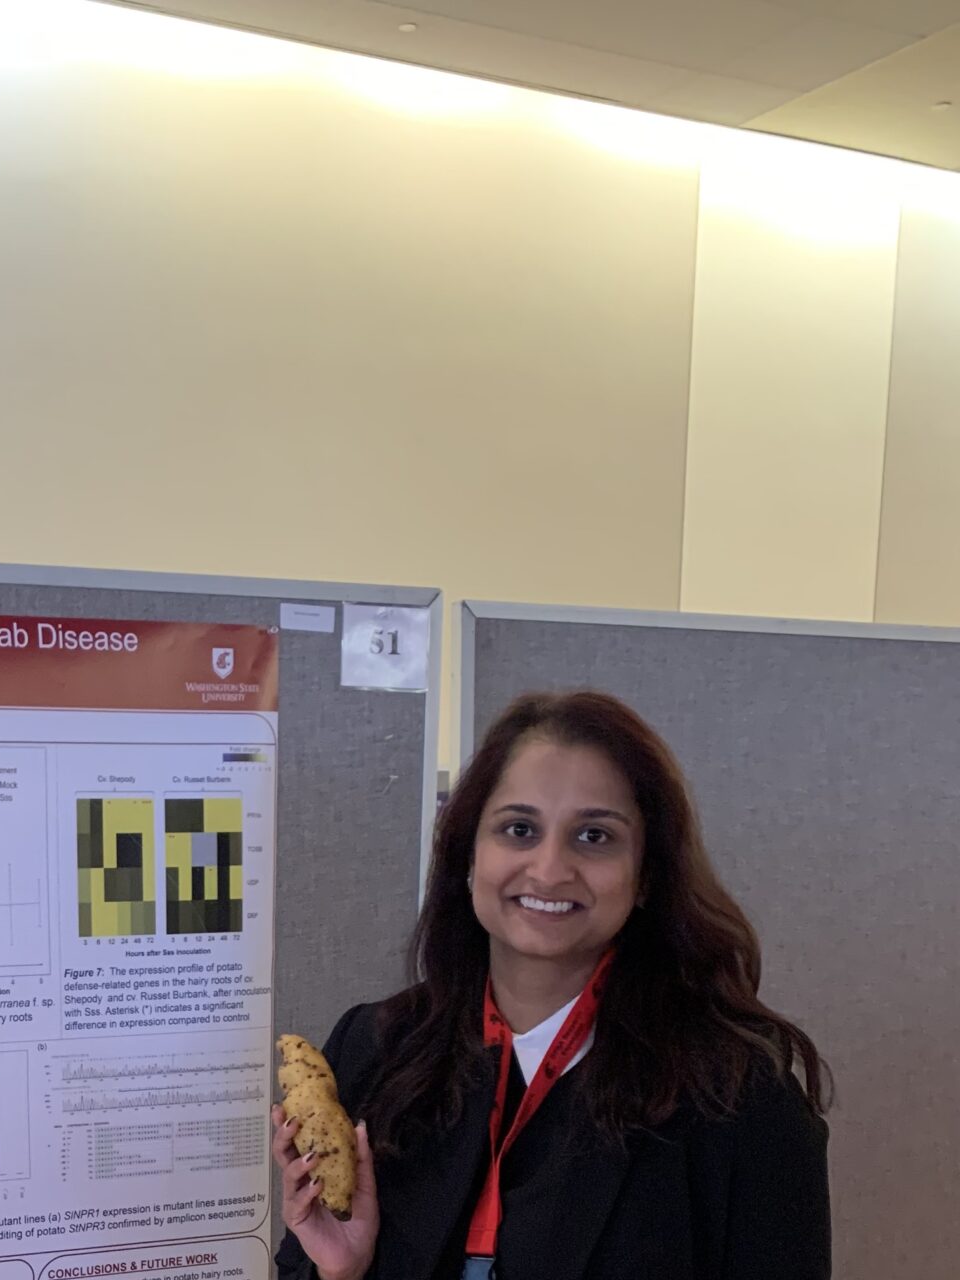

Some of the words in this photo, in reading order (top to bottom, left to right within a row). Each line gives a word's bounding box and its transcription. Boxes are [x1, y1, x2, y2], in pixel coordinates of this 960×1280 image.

[37, 622, 138, 656] Disease
[370, 630, 400, 655] 51
[48, 1263, 127, 1280] CONCLUSIONS
[130, 1261, 137, 1270] &
[141, 1257, 183, 1270] FUTURE
[186, 1253, 218, 1264] WORK
[200, 1271, 221, 1279] hairy
[222, 1267, 243, 1276] roots
